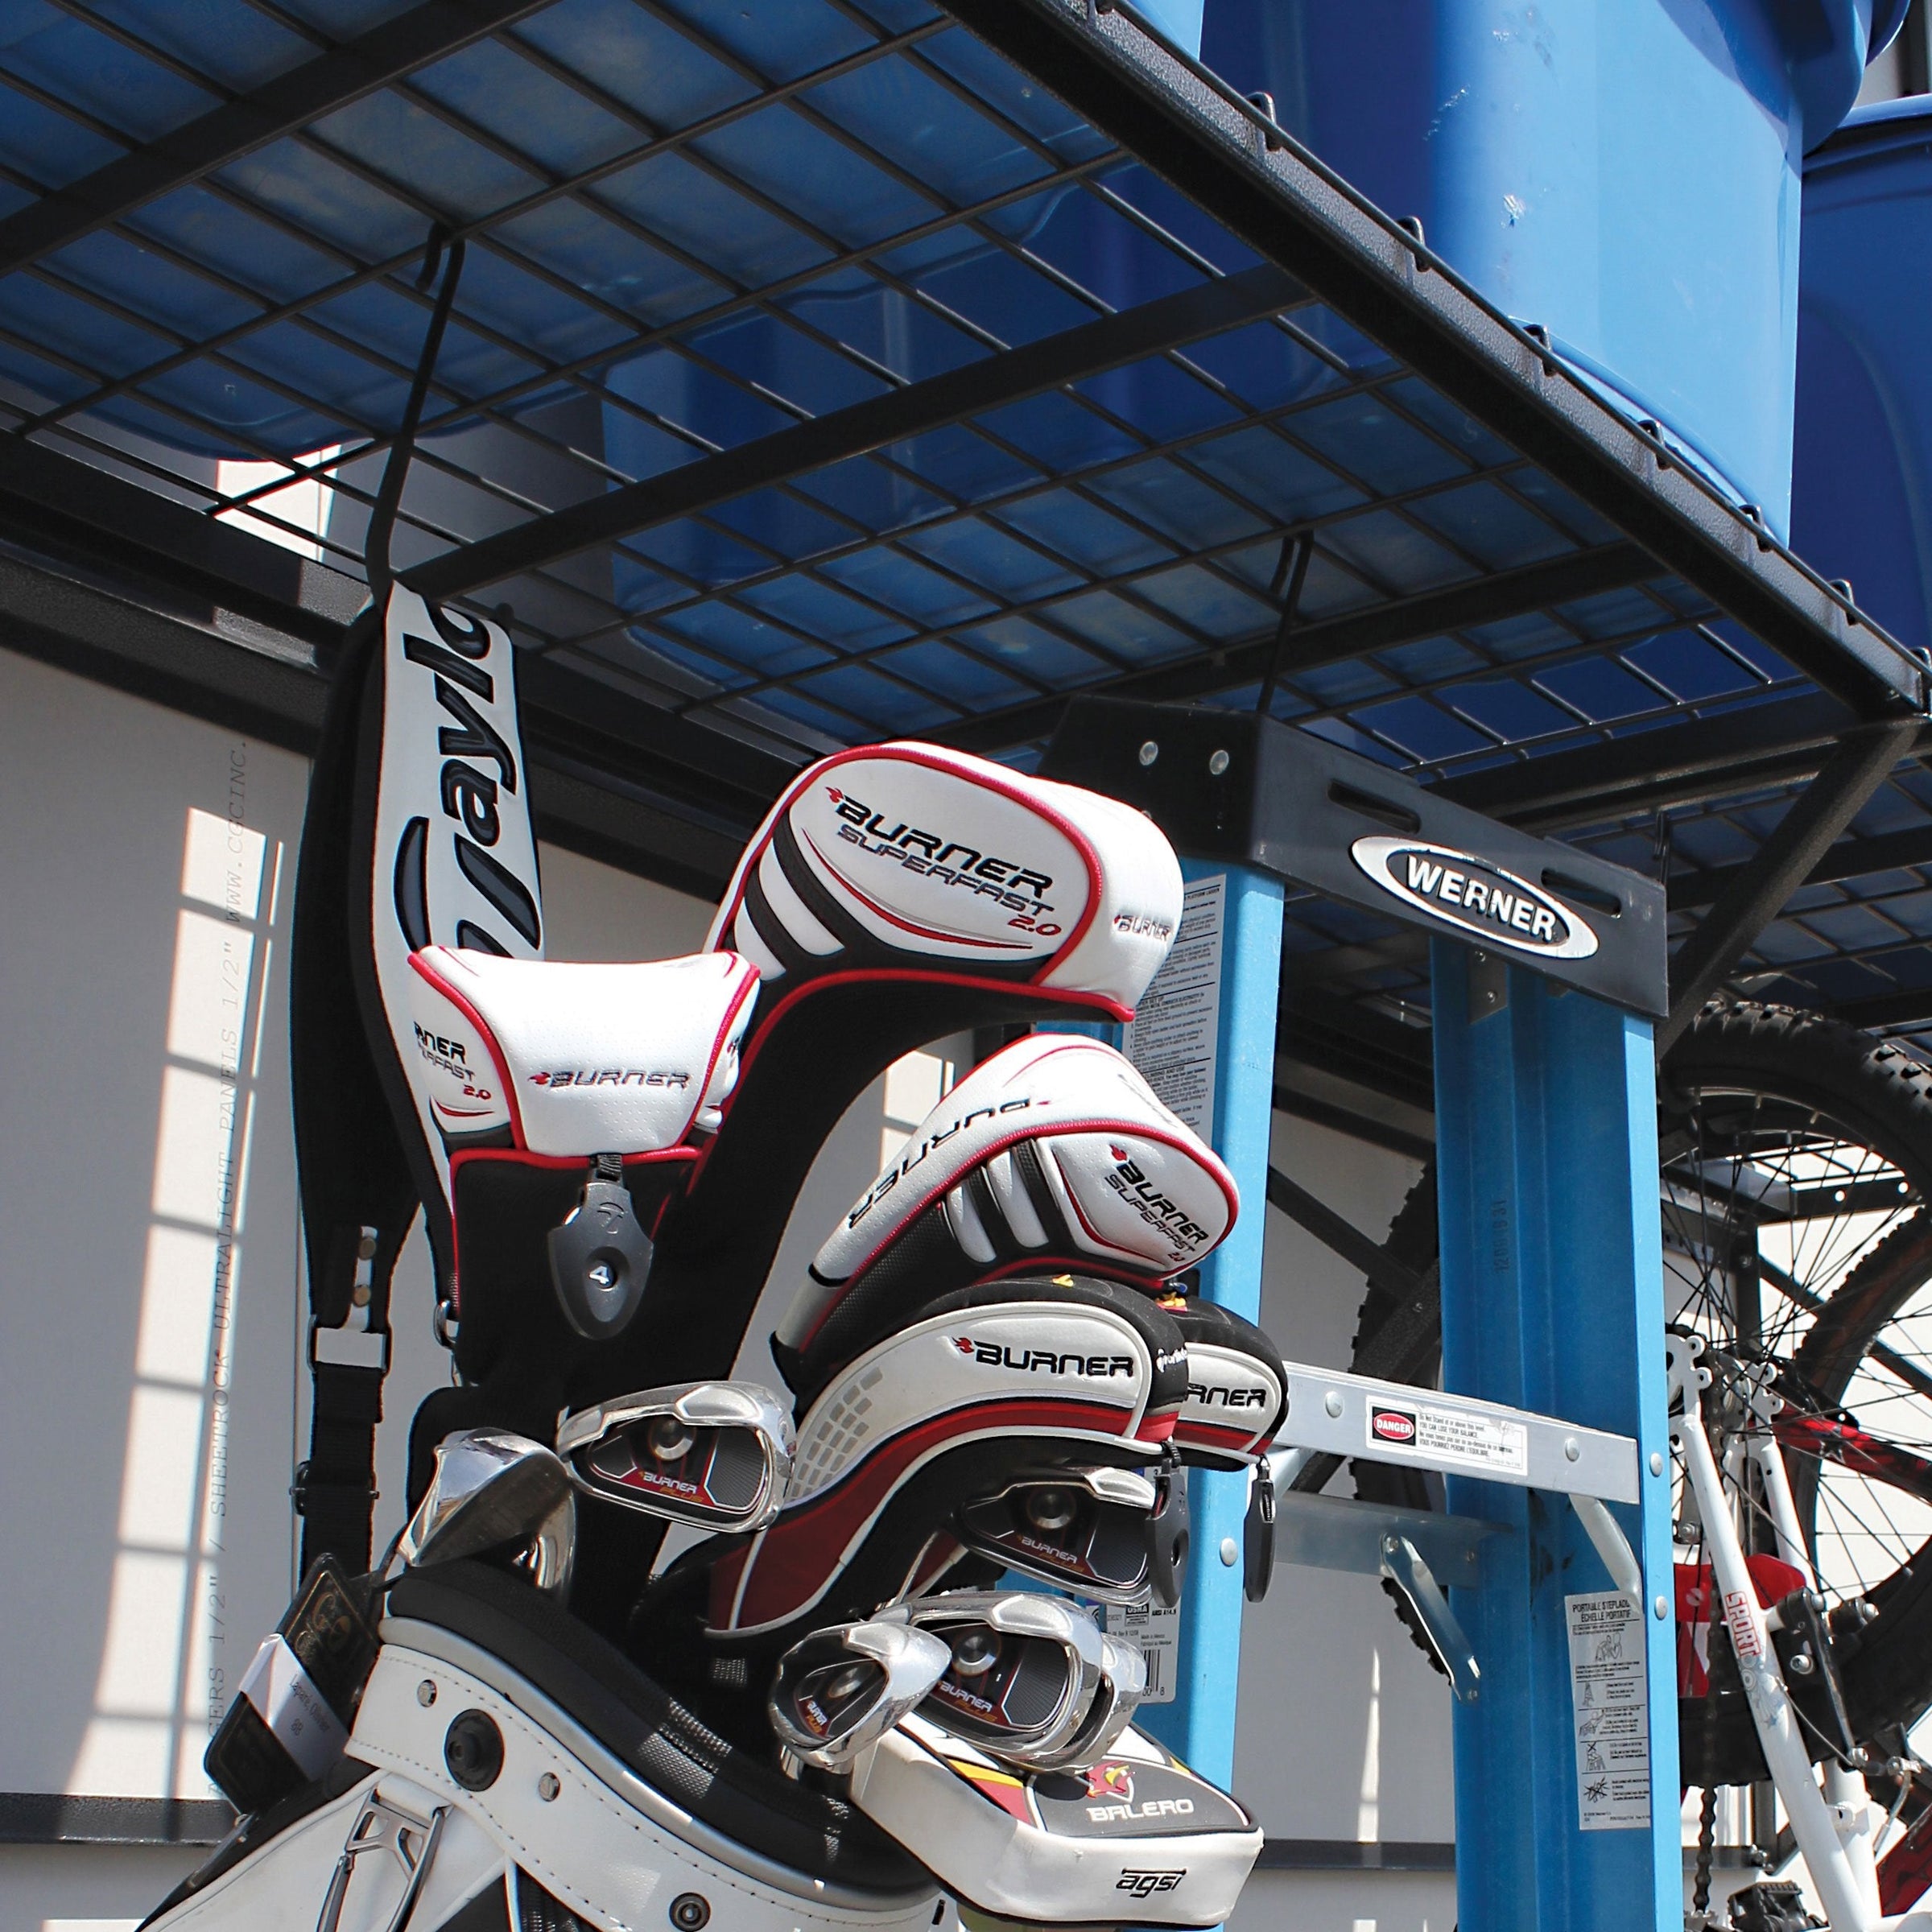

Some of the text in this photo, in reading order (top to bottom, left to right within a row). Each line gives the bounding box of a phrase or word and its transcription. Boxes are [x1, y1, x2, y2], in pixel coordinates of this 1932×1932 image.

[835, 795, 1053, 898] BURNER
[836, 824, 1054, 916] SUPERFAST
[1407, 854, 1556, 943] WERNER
[1009, 915, 1062, 936] 2.0
[1119, 914, 1171, 942] BURNER
[220, 1029, 238, 1131] PANELS
[463, 1084, 491, 1100] 2.0
[550, 1070, 691, 1090] BURNER
[1104, 1173, 1196, 1253] SUPERFAST
[1117, 1161, 1208, 1244] BURNER
[214, 1151, 233, 1330] ULTRALIGHT
[589, 1266, 610, 1285] 4
[974, 1340, 1135, 1377] BURNER
[1376, 1418, 1411, 1435] DANGER
[643, 1472, 698, 1494] BURNER
[1022, 1536, 1078, 1564] BURNER
[1725, 1591, 1762, 1657] SPORT
[940, 1682, 993, 1712] BURNER
[1086, 1798, 1195, 1822] BALERO
[1116, 1868, 1187, 1898] agsi
